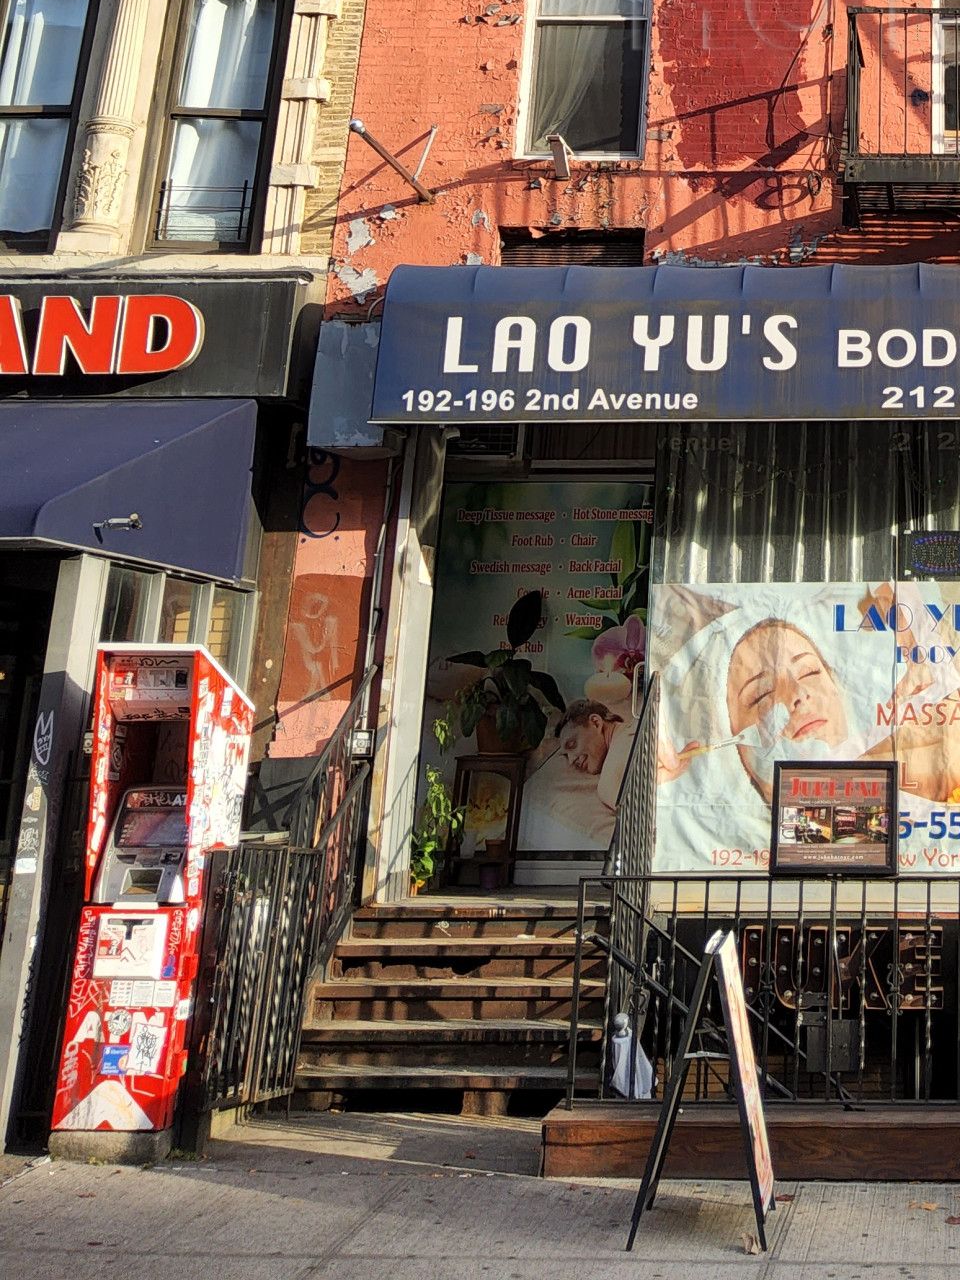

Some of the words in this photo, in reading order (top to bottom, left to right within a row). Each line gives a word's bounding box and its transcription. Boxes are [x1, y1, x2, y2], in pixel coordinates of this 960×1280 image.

[443, 315, 592, 374] LAO
[632, 314, 798, 372] YU'S
[401, 389, 515, 412] 192-196
[524, 388, 580, 412] 2nd
[587, 388, 699, 411] Avenue
[458, 509, 483, 524] Deep
[484, 508, 514, 521] Tissue
[573, 507, 590, 520] Hot
[591, 507, 618, 520] Stone
[619, 508, 655, 524] messag
[511, 534, 533, 547] Foot
[534, 534, 554, 547] Rub
[470, 560, 510, 573] Swedish
[569, 560, 593, 573] Back
[594, 559, 622, 573] Facial
[567, 587, 591, 599] Acne
[594, 586, 623, 599] Facial
[566, 613, 602, 628] Waxing
[832, 602, 914, 633] LAO
[524, 640, 544, 653] Rub
[711, 848, 770, 867] 192-19
